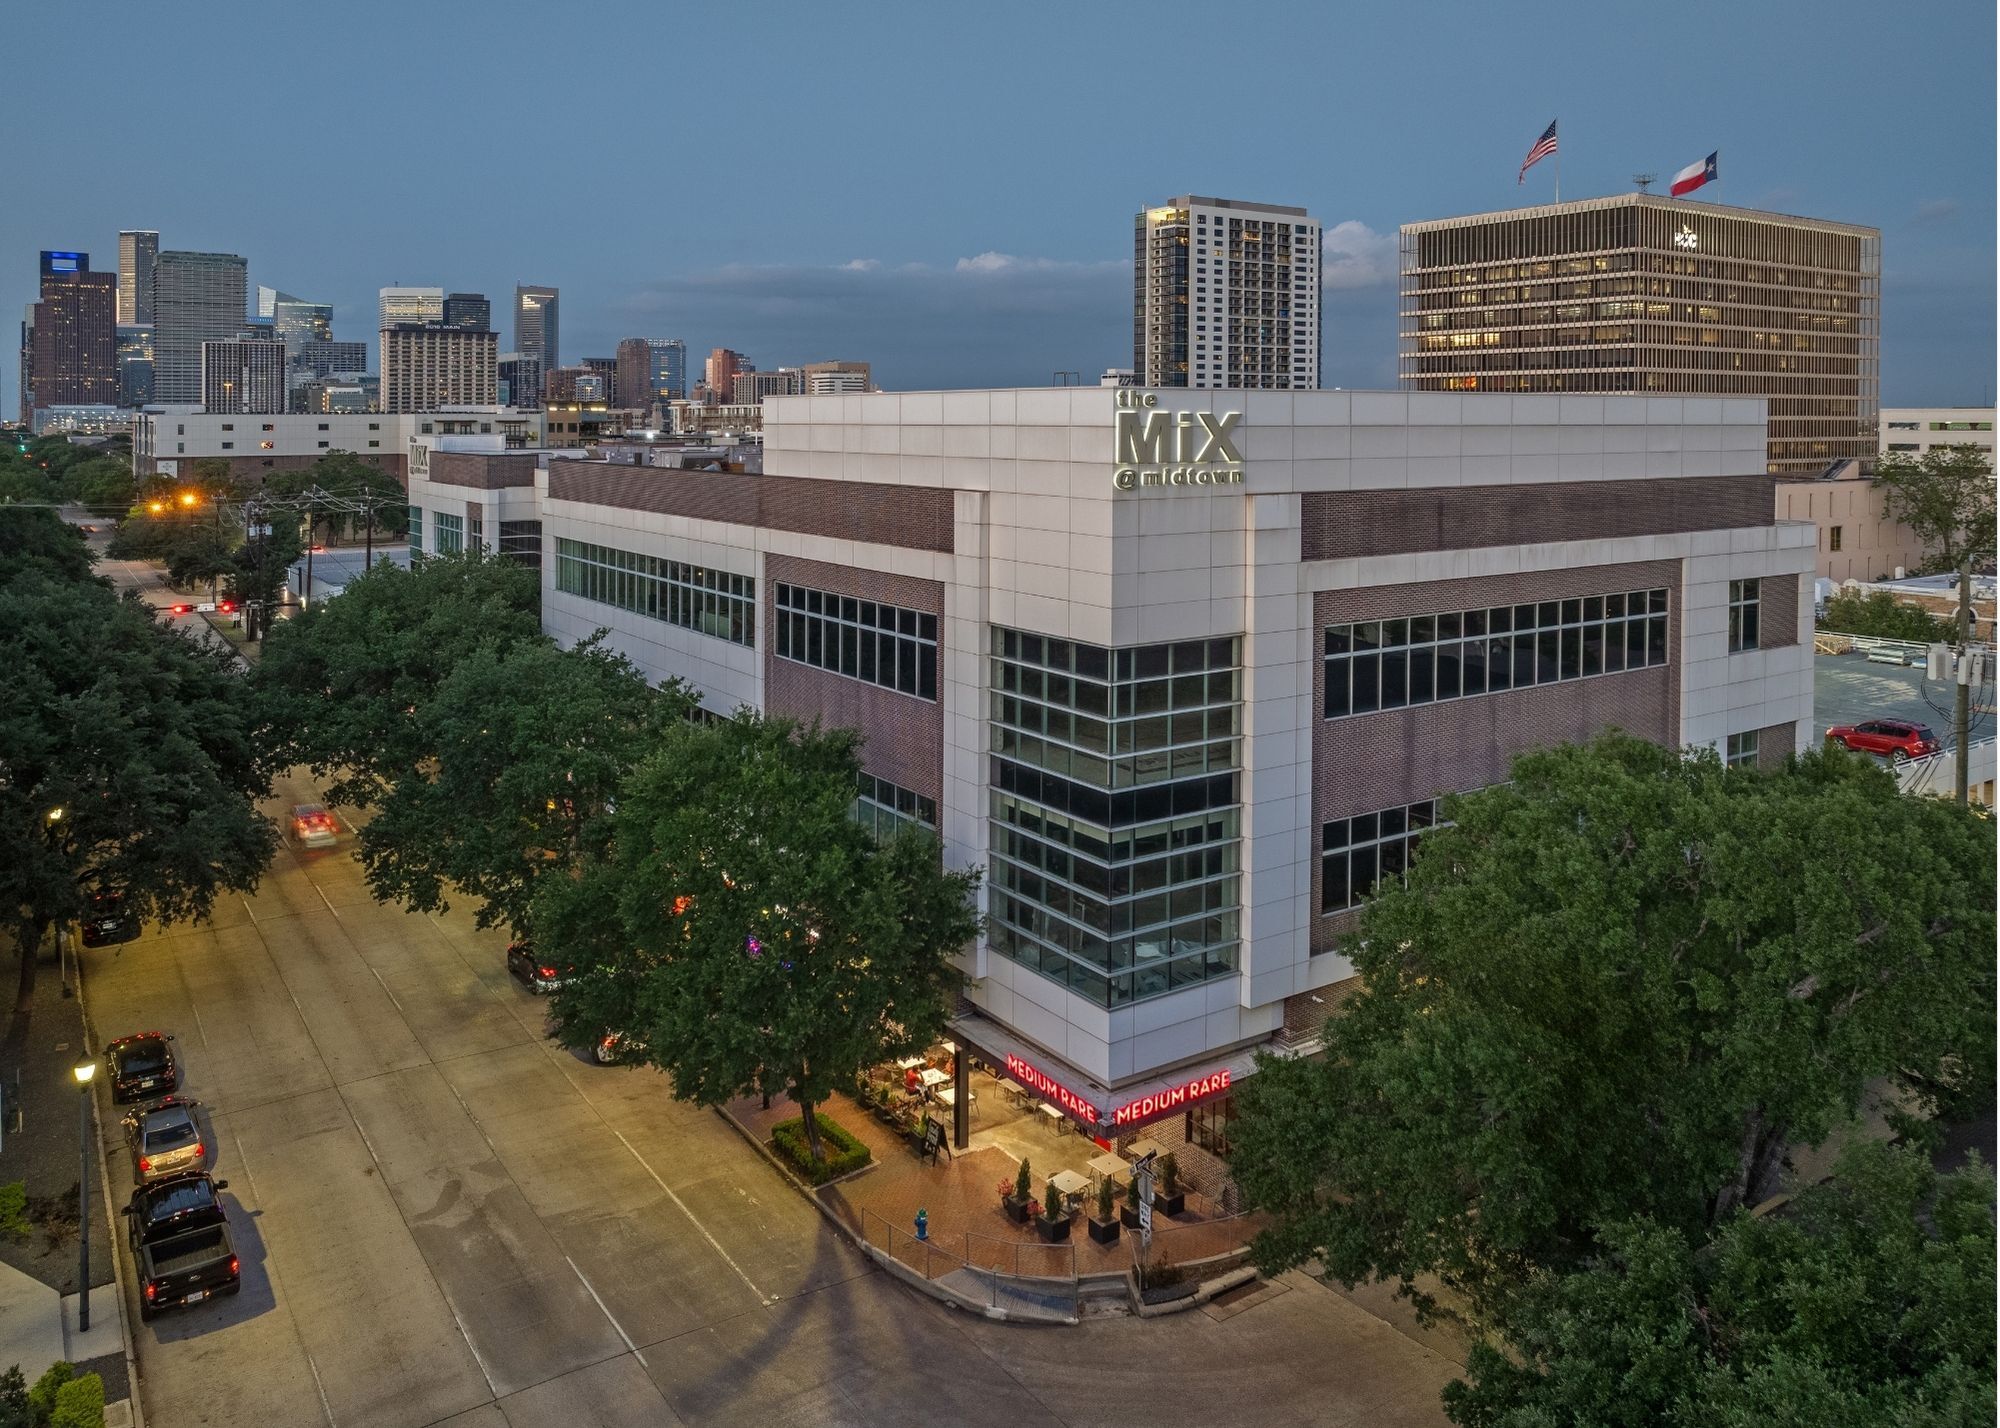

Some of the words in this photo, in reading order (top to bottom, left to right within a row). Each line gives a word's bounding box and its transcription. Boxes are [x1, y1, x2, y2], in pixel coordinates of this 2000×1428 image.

[1116, 390, 1158, 408] the
[1115, 410, 1243, 464] MiX
[1114, 467, 1243, 490] @midtown
[1007, 1053, 1059, 1099] MEDIUM
[1060, 1088, 1097, 1123] RARE
[1116, 1088, 1185, 1125] MEDIUM
[1189, 1071, 1231, 1099] RARE
